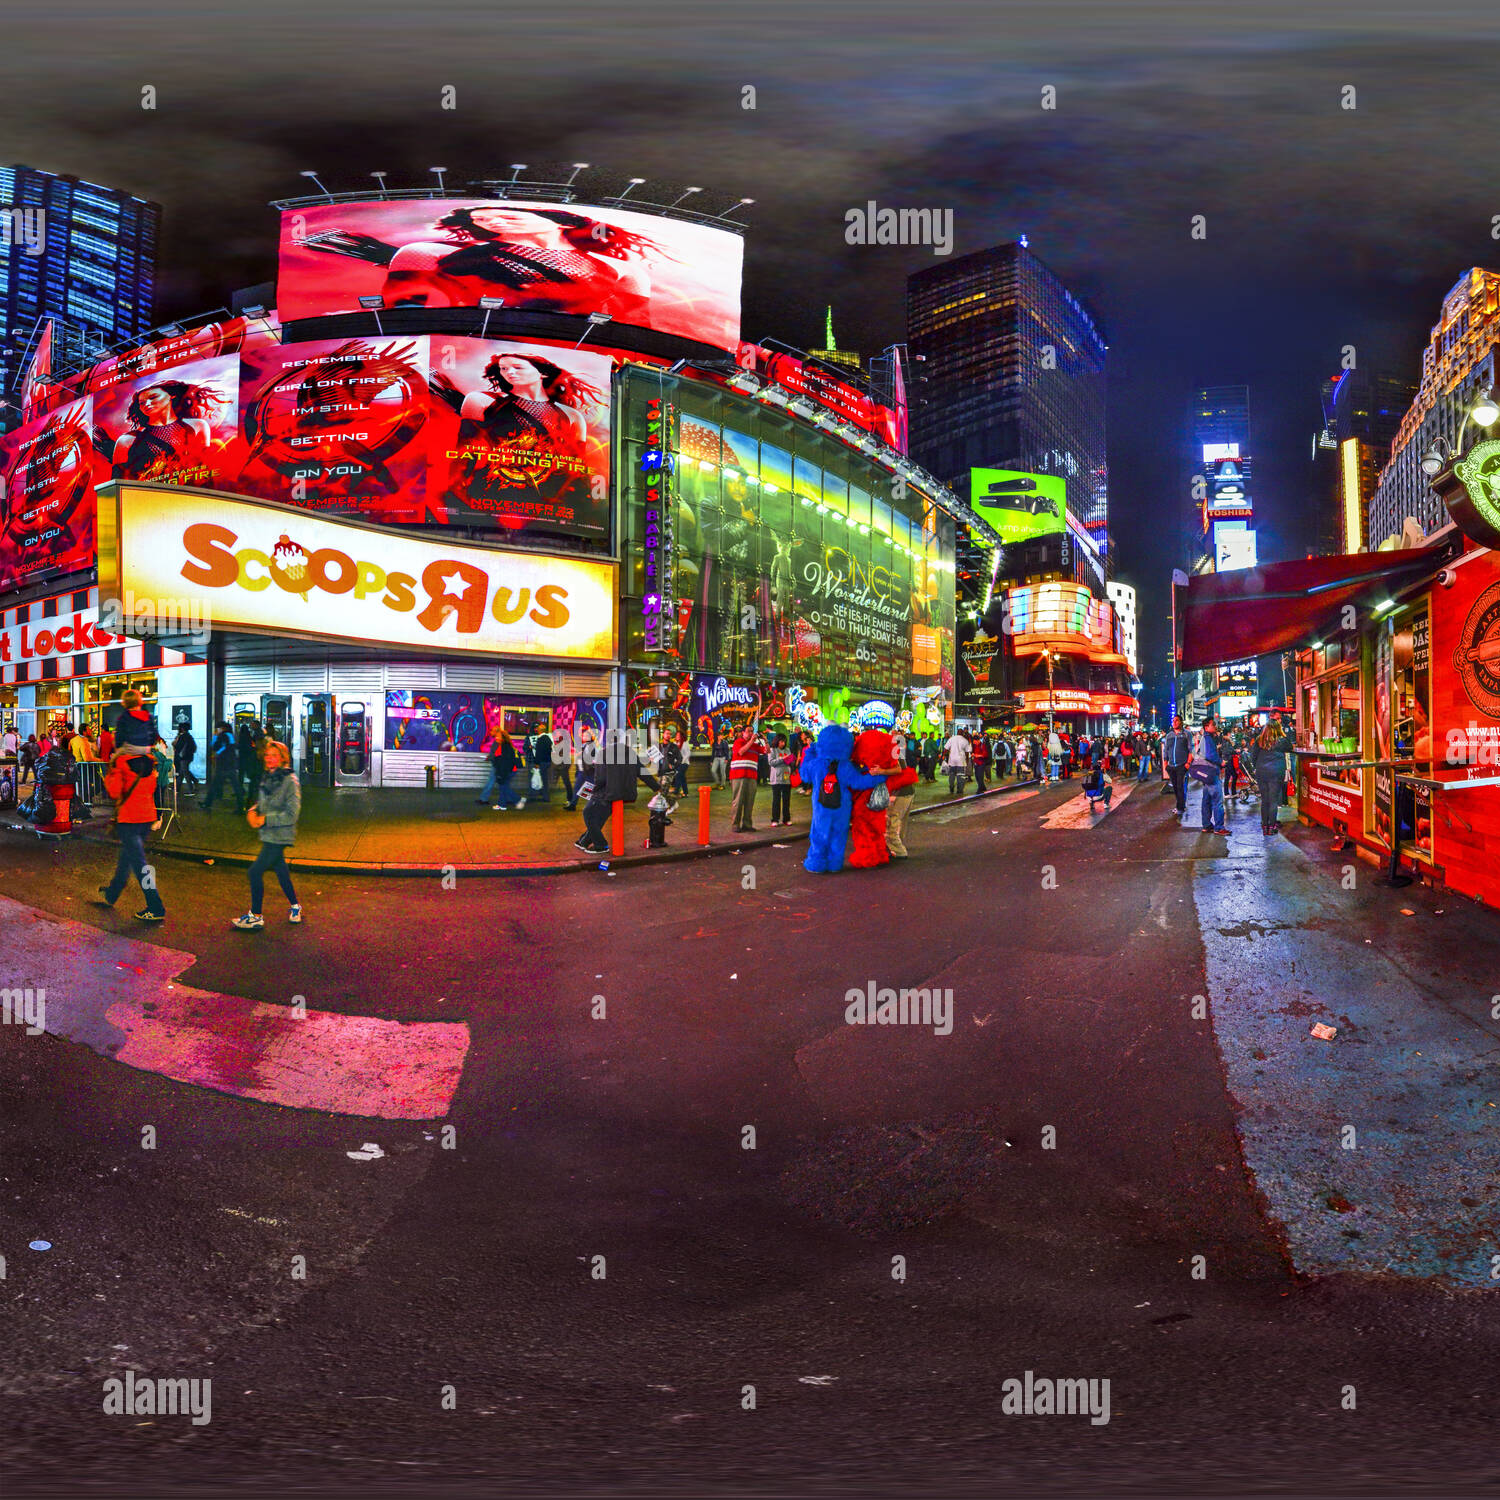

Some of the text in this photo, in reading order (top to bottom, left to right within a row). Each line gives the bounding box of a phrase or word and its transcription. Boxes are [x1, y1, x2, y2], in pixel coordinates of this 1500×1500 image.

[100, 373, 131, 388] GIRL
[163, 346, 199, 363] FIRE
[282, 354, 381, 369] REMEMBER
[274, 377, 388, 393] GIRL ON FIRE
[794, 366, 859, 402] REMEMBER
[786, 375, 864, 418] GIRL ON FIRE
[292, 403, 370, 416] I'M STILL
[647, 399, 661, 445] TOYS
[290, 432, 369, 447] BETTING
[464, 444, 488, 452] THE
[493, 447, 542, 458] HUNGER
[15, 461, 35, 475] GIRL
[36, 455, 50, 465] ON
[294, 465, 363, 479] ON YOU
[446, 450, 598, 475] CATCHING FIRE
[184, 467, 221, 485] FIRE
[471, 498, 574, 515] NOVEMBER 22
[25, 528, 60, 547] ON YOU
[1061, 533, 1069, 566] 1500
[804, 562, 910, 622] Wonderland
[836, 617, 846, 631] 10
[21, 613, 126, 658] Locke
[856, 647, 877, 663] abc
[698, 677, 753, 712] WONKA
